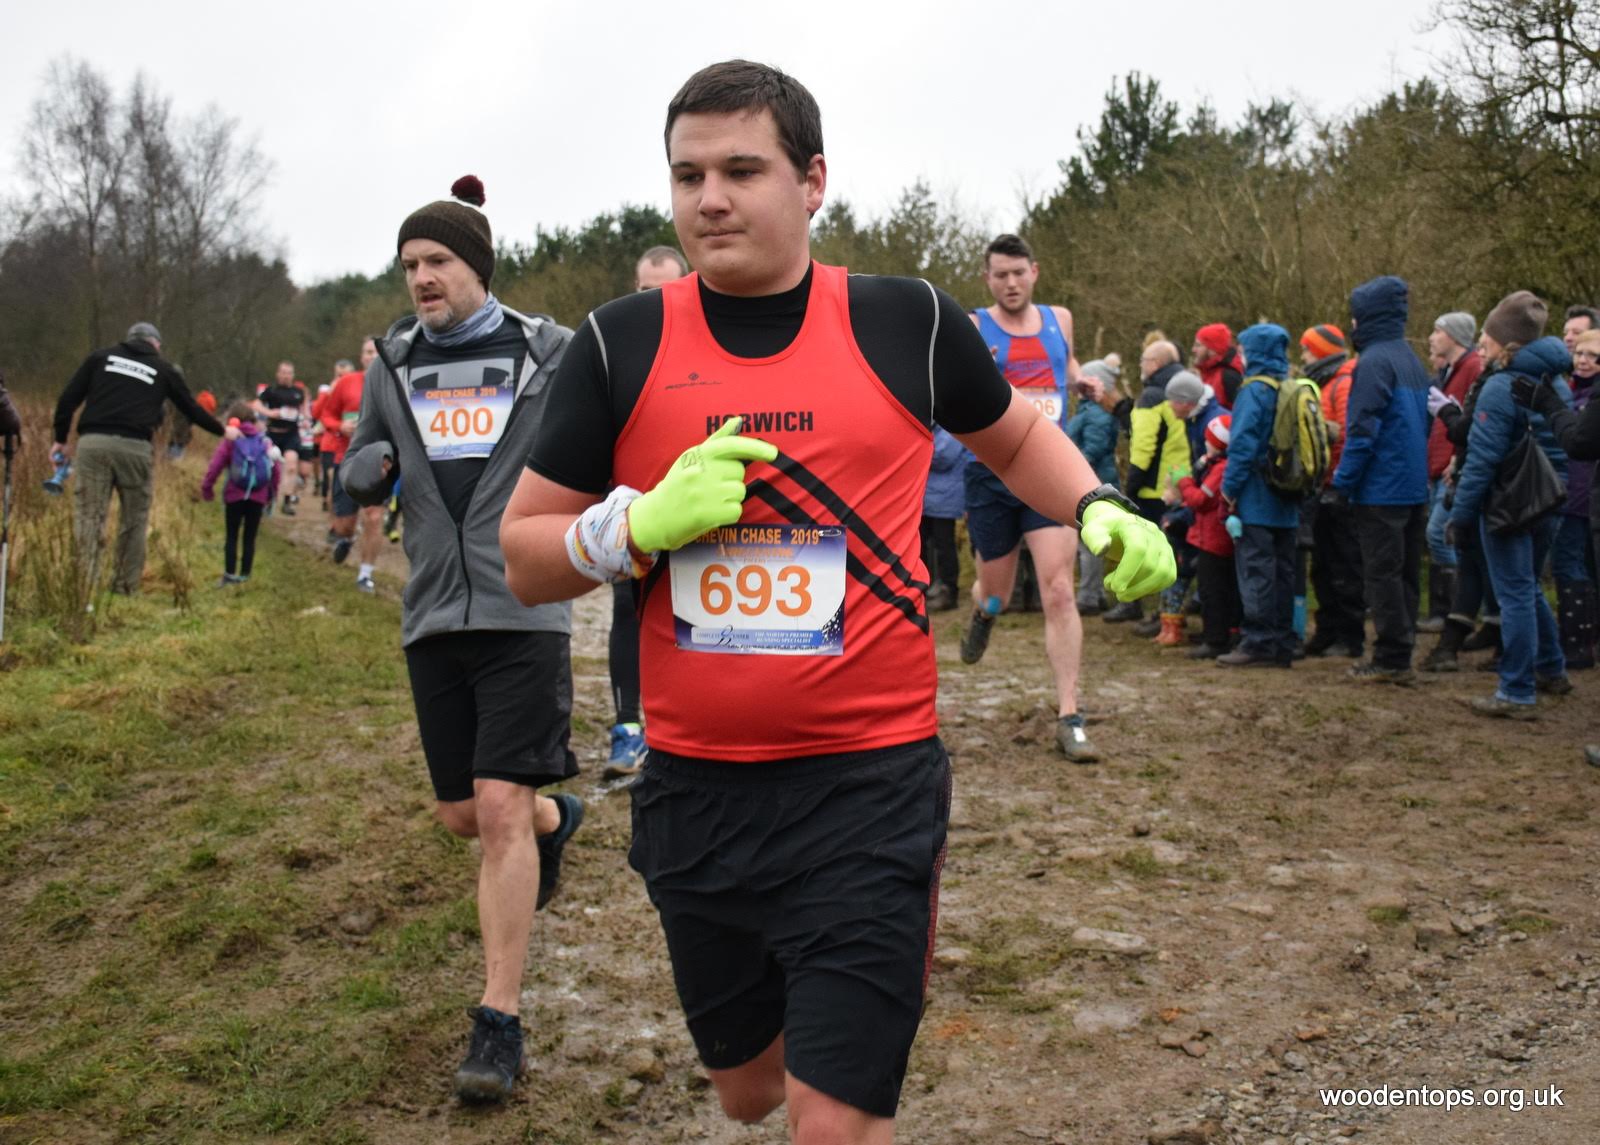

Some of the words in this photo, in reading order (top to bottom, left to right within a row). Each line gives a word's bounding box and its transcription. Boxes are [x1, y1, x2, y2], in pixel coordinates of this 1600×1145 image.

[430, 407, 493, 438] 400
[741, 528, 781, 544] CHASE
[791, 529, 820, 545] 2019
[700, 564, 812, 617] 693
